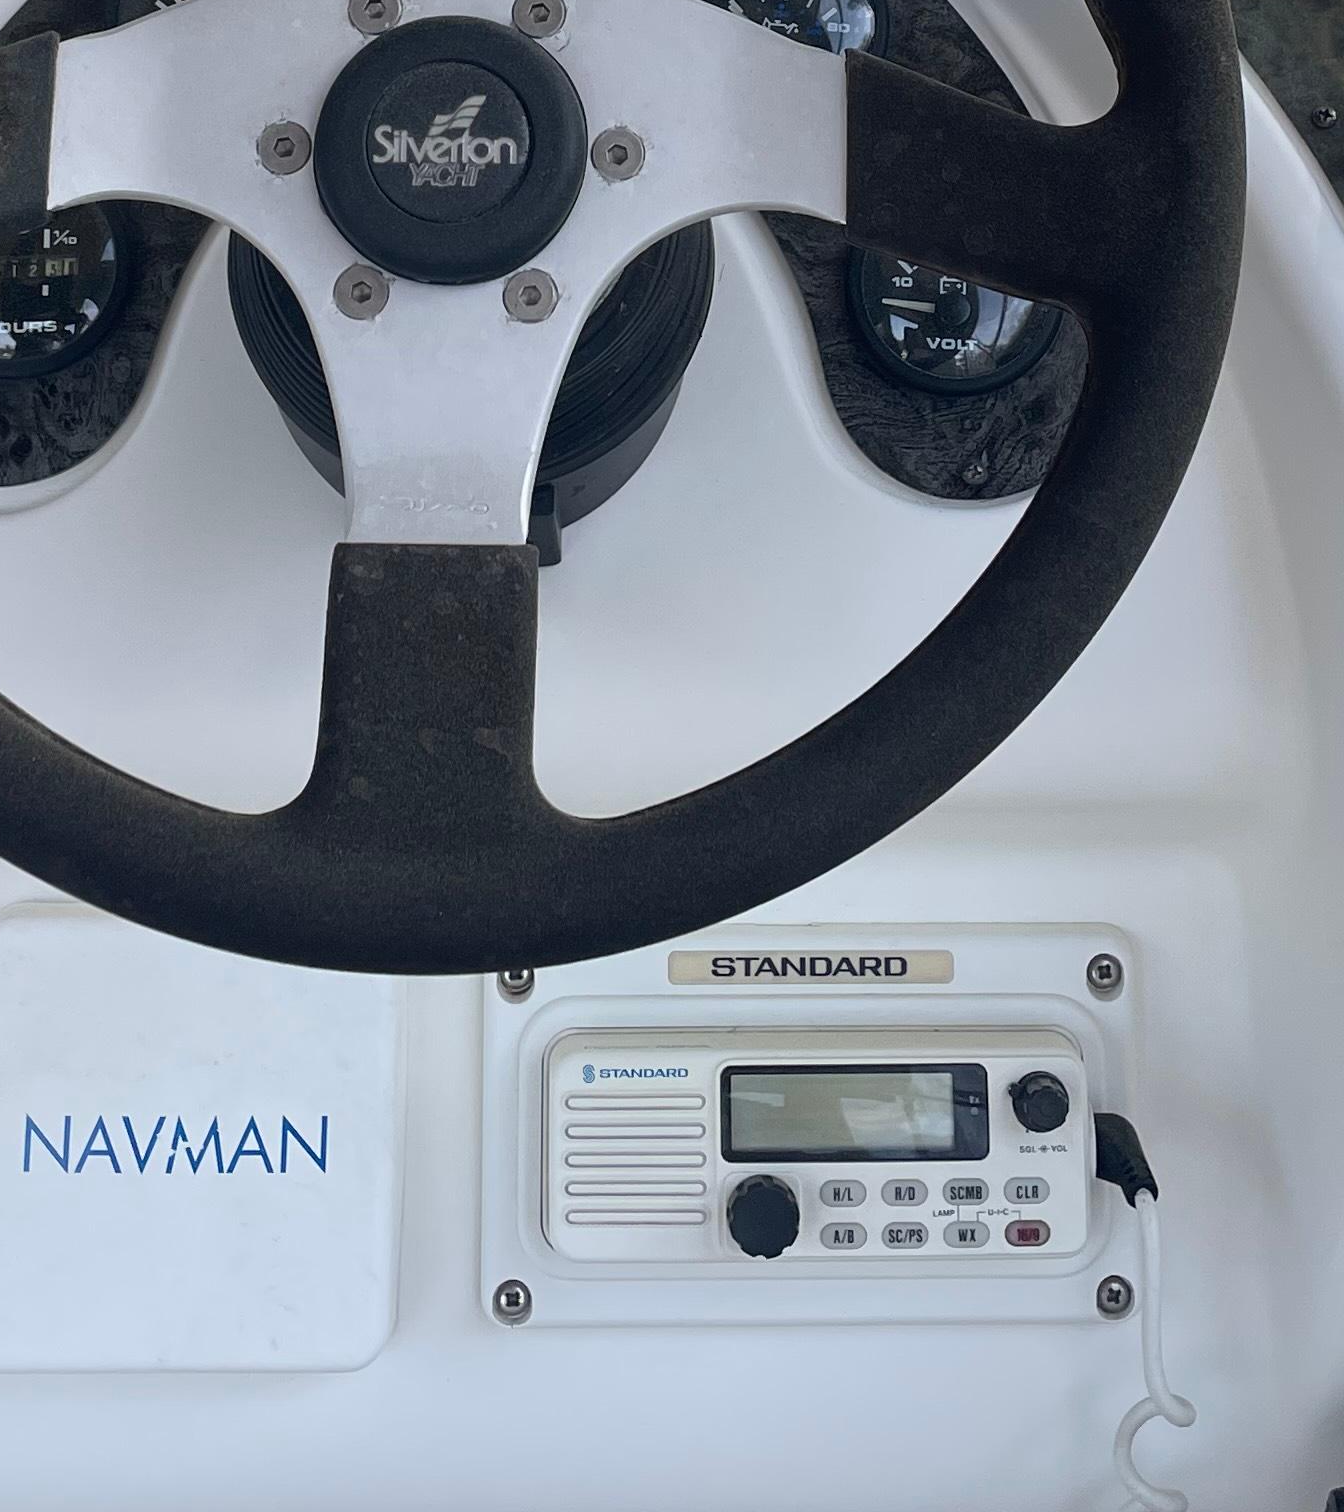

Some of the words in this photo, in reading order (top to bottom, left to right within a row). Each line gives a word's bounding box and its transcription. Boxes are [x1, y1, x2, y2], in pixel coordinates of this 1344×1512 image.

[372, 125, 518, 165] Silverton
[409, 162, 486, 187] YACHT
[891, 276, 914, 288] 10
[925, 337, 978, 351] VOLT
[711, 956, 908, 978] STANDARD
[599, 1067, 689, 1079] STANDARD
[23, 1112, 329, 1176] NAVMAN
[1051, 1144, 1068, 1153] VOL
[832, 1187, 854, 1202] H/L
[949, 1185, 983, 1200] SCMB
[1016, 1185, 1039, 1199] CLR
[932, 1209, 956, 1218] LAMP
[833, 1229, 855, 1244] A/B
[888, 1228, 923, 1243] SC/PS
[958, 1228, 977, 1243] WX
